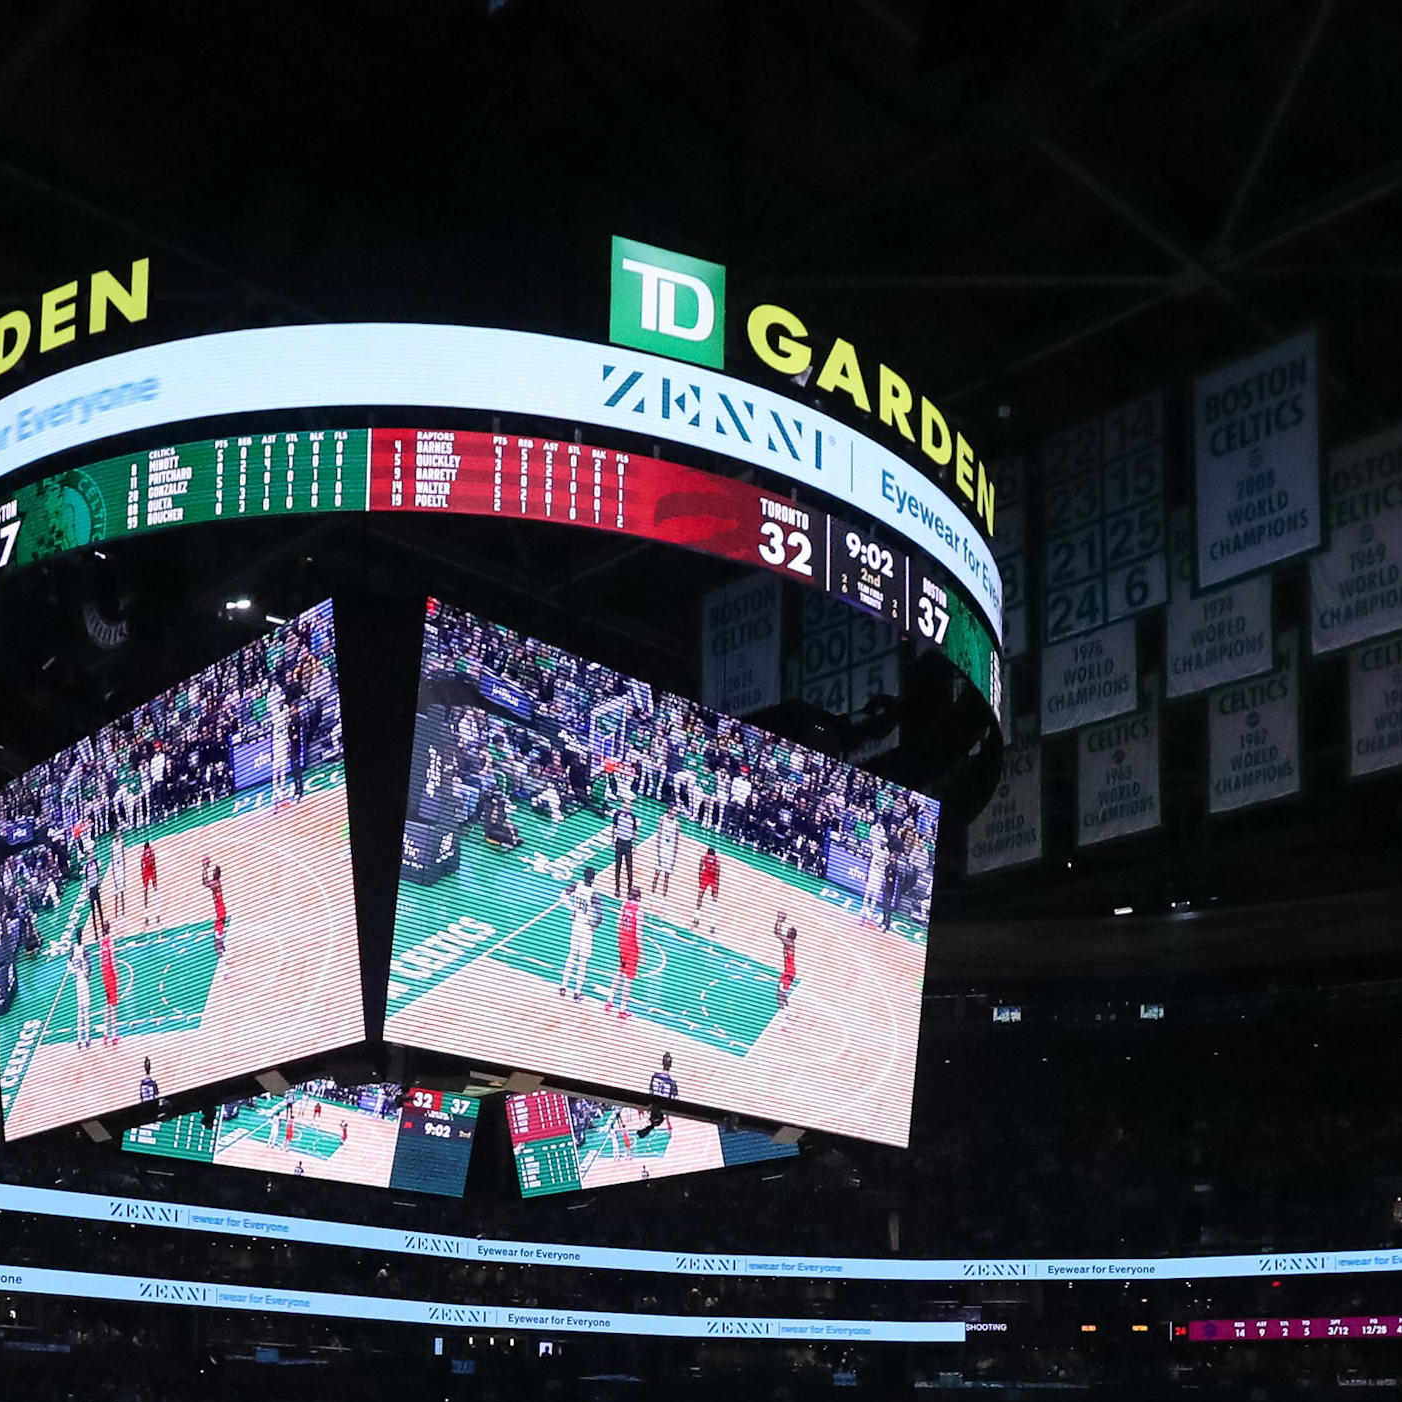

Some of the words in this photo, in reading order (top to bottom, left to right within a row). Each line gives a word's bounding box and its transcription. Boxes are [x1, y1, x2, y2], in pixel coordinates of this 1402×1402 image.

[622, 258, 716, 342] TD
[747, 303, 995, 536] GARDEN
[1205, 355, 1309, 424] BOSTON
[15, 377, 160, 442] Everyone
[416, 431, 455, 442] RAPTORS
[1209, 395, 1304, 458] CELTICS
[415, 454, 461, 468] QUICKLEY
[416, 441, 453, 455] BARNES
[148, 456, 180, 472] MINOTT
[148, 467, 193, 486] PRITCHARD
[415, 468, 458, 482] BARRETT
[602, 364, 823, 471] ZENNI
[882, 468, 960, 552] Eyewear
[963, 537, 982, 576] for
[147, 481, 189, 500] GONZALEZ
[414, 481, 451, 495] WALTER
[414, 494, 448, 508] POELTL
[146, 508, 184, 526] BOUCHER
[759, 497, 810, 531] TORONTO
[1227, 490, 1289, 529] WORLD
[758, 521, 814, 577] 32
[1110, 510, 1160, 562] 25
[1209, 509, 1309, 561] CHAMPIONS
[845, 531, 894, 578] 9:02
[1051, 541, 1096, 582] 21
[860, 567, 882, 588] 2nd
[922, 577, 947, 608] BOSTON
[1125, 565, 1149, 607] 6
[1339, 564, 1399, 600] WORLD
[917, 596, 950, 645] 37
[1051, 585, 1098, 637] 24
[710, 611, 773, 656] CELTICS
[1190, 615, 1246, 648] WORLD
[1172, 633, 1265, 674] CHAMPIONS
[1063, 658, 1115, 687] WORLD
[1048, 675, 1129, 713] CHAMPIONS
[1218, 676, 1288, 715] CELTICS
[1087, 719, 1148, 752] CELTICS
[1230, 746, 1278, 772] WORLD
[1098, 782, 1140, 806] WORLD
[1214, 761, 1293, 796] CHAMPIONS
[1084, 799, 1154, 828] CHAMPIONS
[412, 1091, 433, 1109] 32
[449, 1098, 471, 1115] 37
[423, 1122, 451, 1138] 9:02
[110, 1202, 178, 1223] ZENNI
[404, 1235, 460, 1254] ZENNI
[477, 1244, 519, 1258] Eyewear
[520, 1247, 534, 1258] for
[536, 1248, 581, 1262] Everyone
[963, 1264, 1026, 1276] ZENNI
[1047, 1265, 1091, 1276] Eyewear
[1092, 1264, 1106, 1274] for
[1108, 1265, 1156, 1276] Everyone
[139, 1283, 206, 1301] ZENNI
[428, 1307, 487, 1323] ZENNI
[507, 1313, 550, 1326] Eyewear
[551, 1315, 565, 1325] for
[567, 1316, 611, 1330] Everyone
[965, 1322, 1007, 1332] SHOOTING
